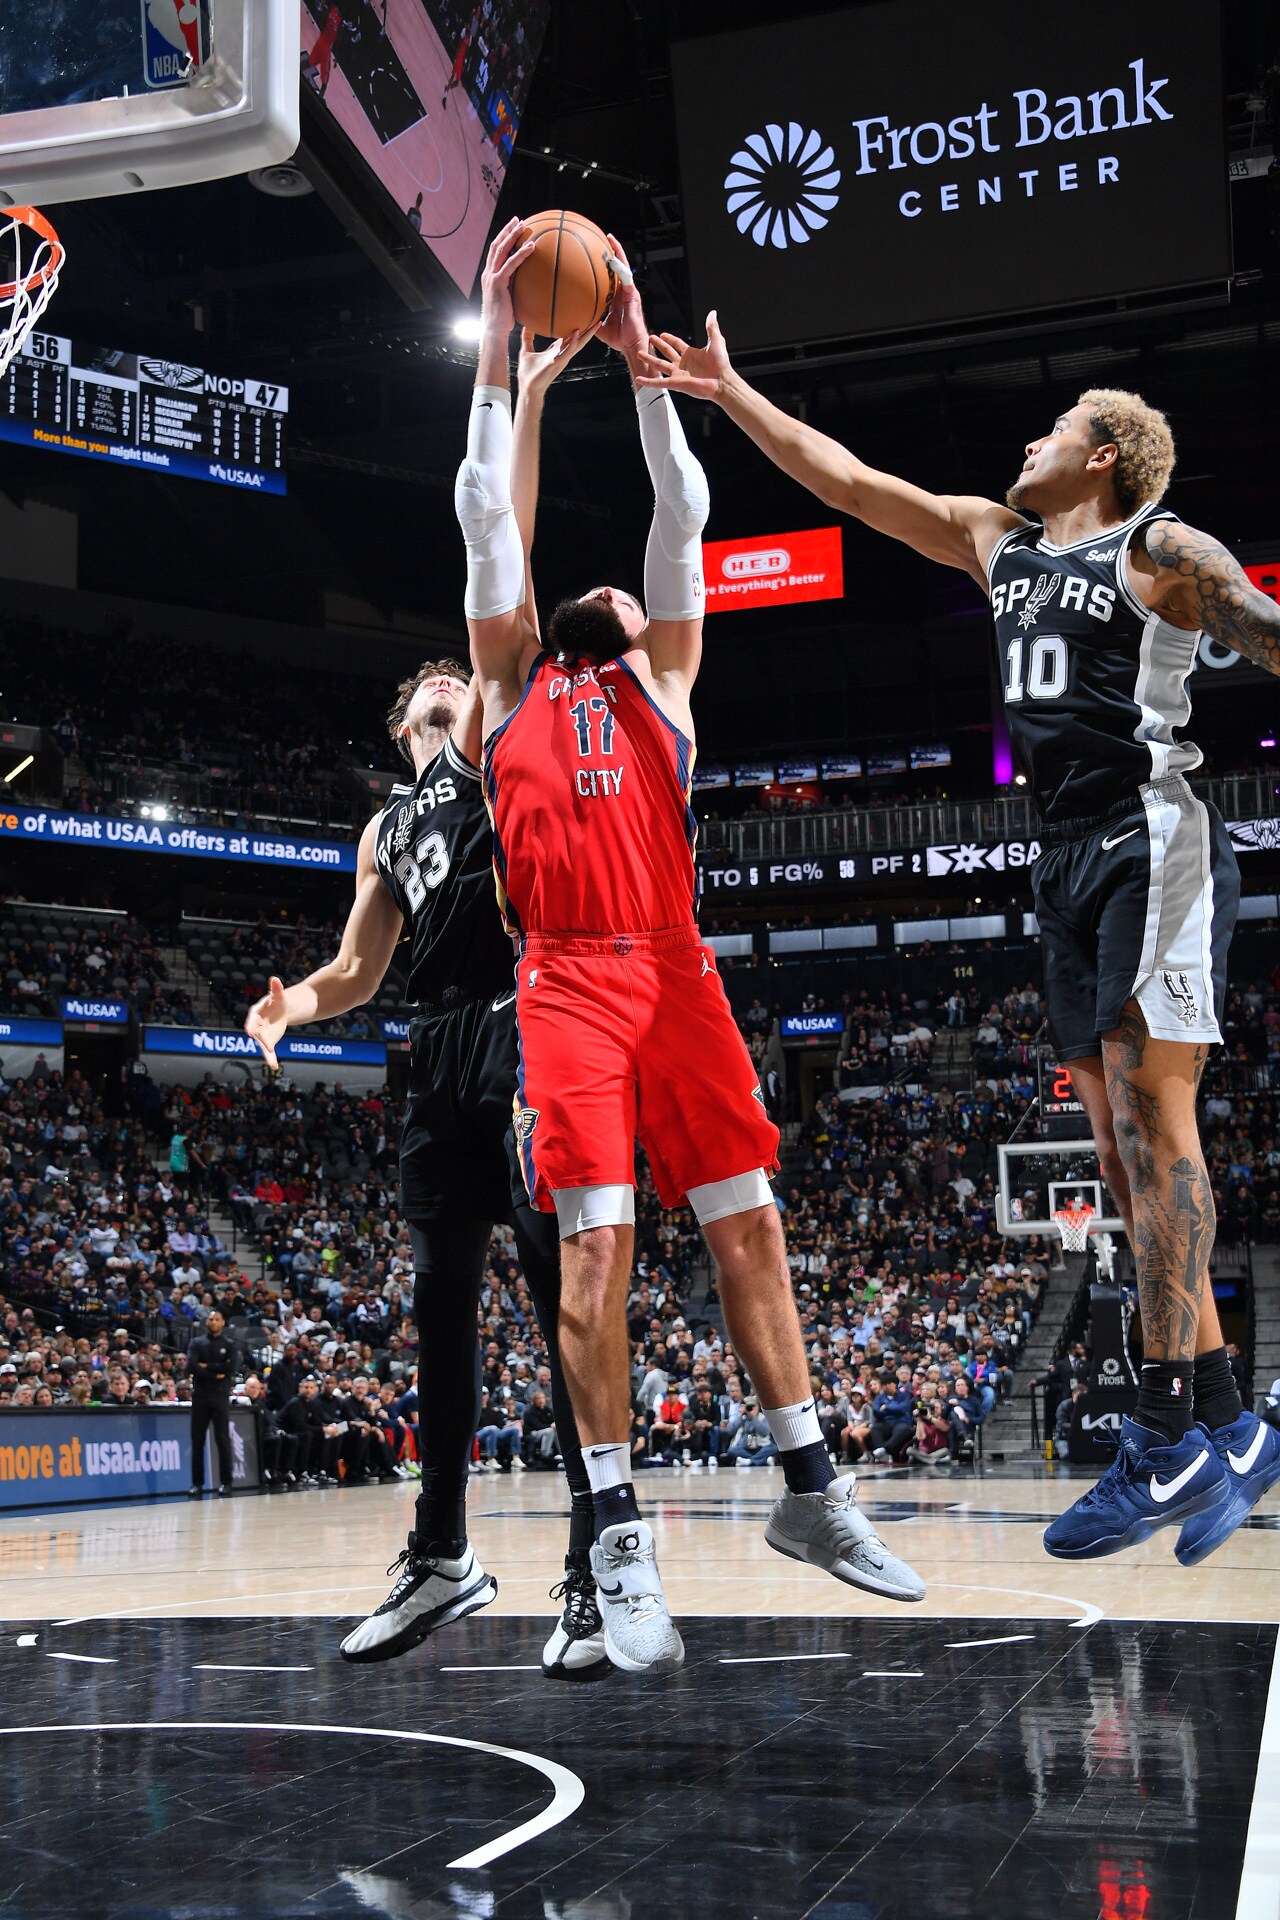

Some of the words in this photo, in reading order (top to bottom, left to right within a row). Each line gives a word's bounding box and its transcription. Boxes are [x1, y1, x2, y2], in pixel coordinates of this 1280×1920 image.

[153, 54, 181, 78] NBA
[852, 102, 1000, 176] Frost
[1012, 58, 1174, 147] Bank
[899, 156, 1120, 218] CENTER
[32, 333, 59, 360] 56
[26, 359, 46, 369] AST
[204, 374, 244, 397] NOP
[255, 384, 279, 408] 47
[208, 399, 226, 408] PTS
[228, 403, 246, 412] REB
[33, 429, 60, 444] More
[62, 435, 87, 449] than
[89, 442, 108, 454] you
[110, 445, 141, 460] might
[142, 450, 170, 466] think
[227, 469, 262, 487] USAA
[718, 576, 786, 595] Everything's
[789, 573, 825, 586] Better
[1005, 634, 1069, 704] 10
[569, 697, 616, 757] 17
[576, 766, 625, 797] CITY
[23, 813, 47, 833] of
[51, 816, 102, 839] what
[106, 822, 164, 845] USAA
[168, 829, 225, 852] offers
[229, 836, 249, 854] at
[253, 840, 340, 864] usaa.com
[393, 830, 451, 914] 23
[708, 869, 741, 887] TO
[750, 867, 759, 886] 5
[769, 862, 823, 883] FG%
[839, 859, 855, 878] 58
[871, 855, 904, 875] PF
[911, 854, 921, 873] 2
[953, 966, 974, 978] 114
[84, 1003, 118, 1017] USAA
[802, 1018, 834, 1031] USAA
[215, 1035, 257, 1054] USAA
[290, 1042, 342, 1055] usaa.com
[1098, 1373, 1125, 1386] Frost
[1081, 1413, 1123, 1430] KI
[0, 1444, 54, 1481] more
[59, 1436, 82, 1477] at
[85, 1439, 180, 1476] usaa.com
